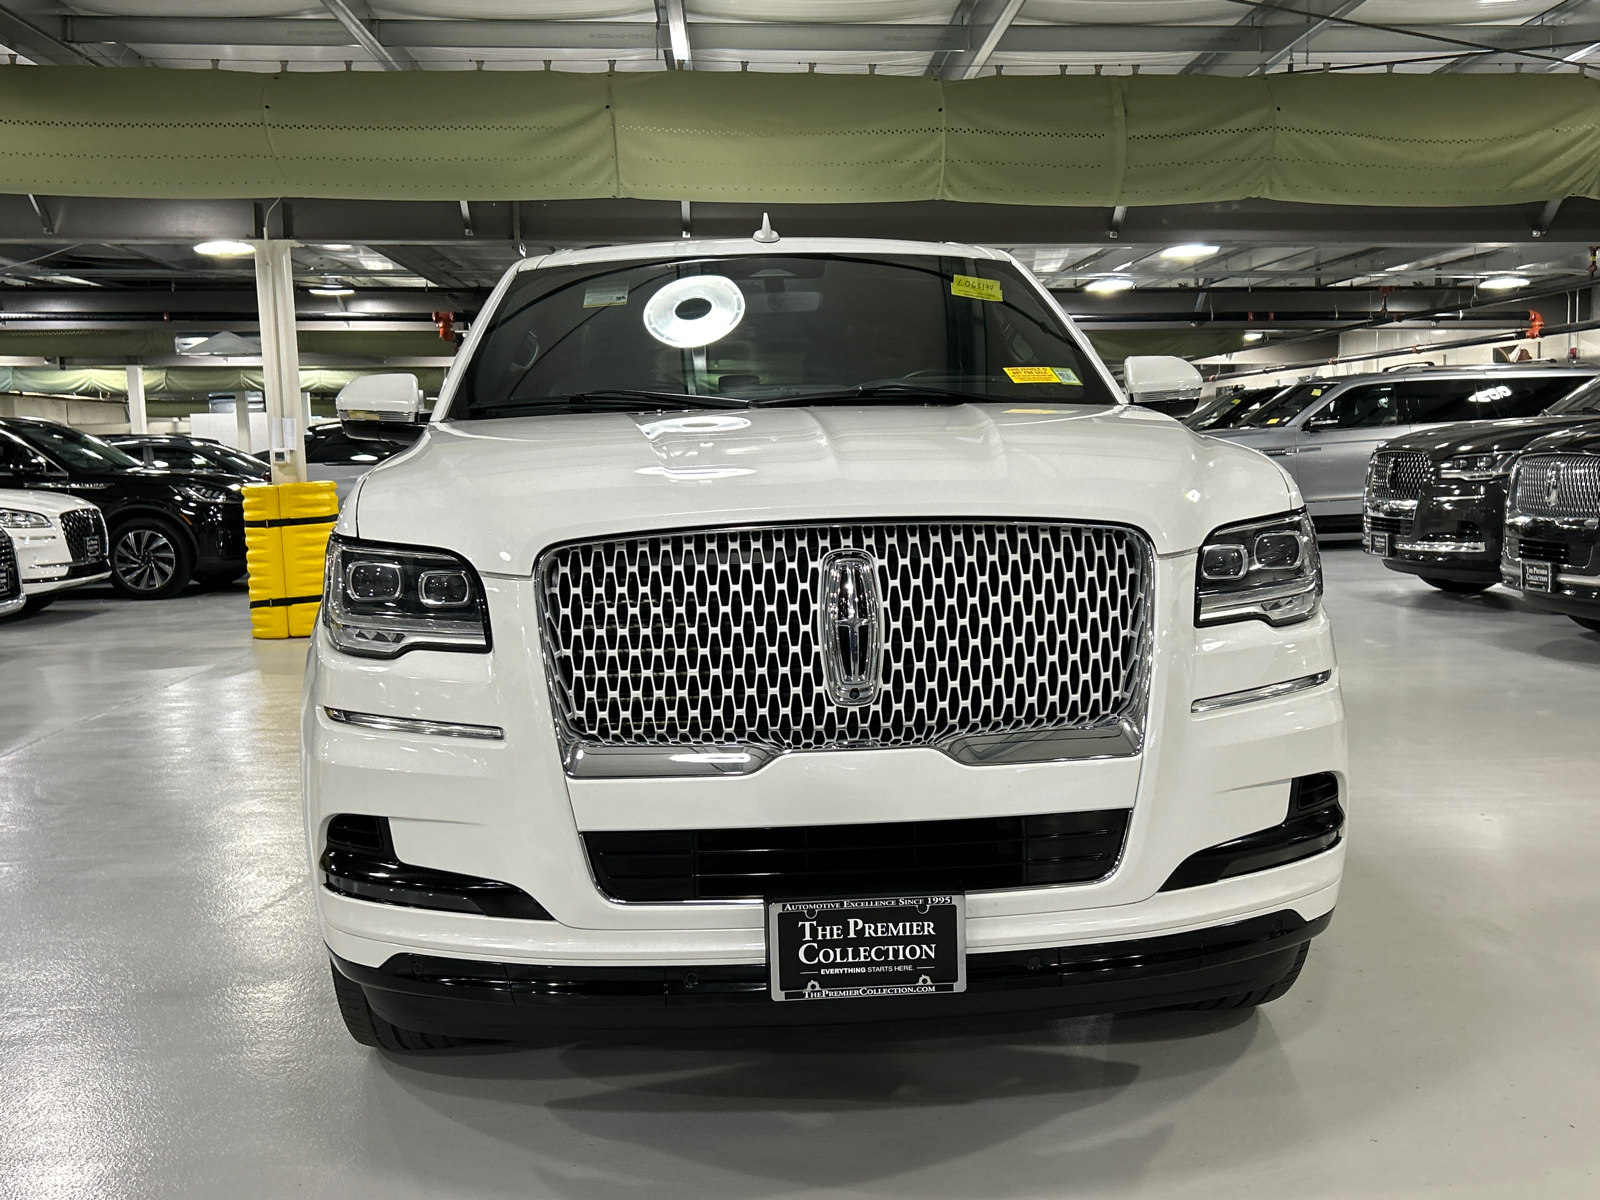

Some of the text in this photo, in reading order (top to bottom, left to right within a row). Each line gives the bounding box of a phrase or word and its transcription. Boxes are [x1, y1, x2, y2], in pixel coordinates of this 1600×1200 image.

[784, 896, 951, 911] AUTOMOTIVE EXCELLENCE SINCE 1995
[798, 918, 936, 941] THE PREMIER
[798, 942, 937, 965] COLLECTION
[820, 966, 866, 975] EVERYTHING
[867, 965, 894, 973] STARTS
[803, 985, 936, 999] THEPREMIERCOLLECTION.COM
